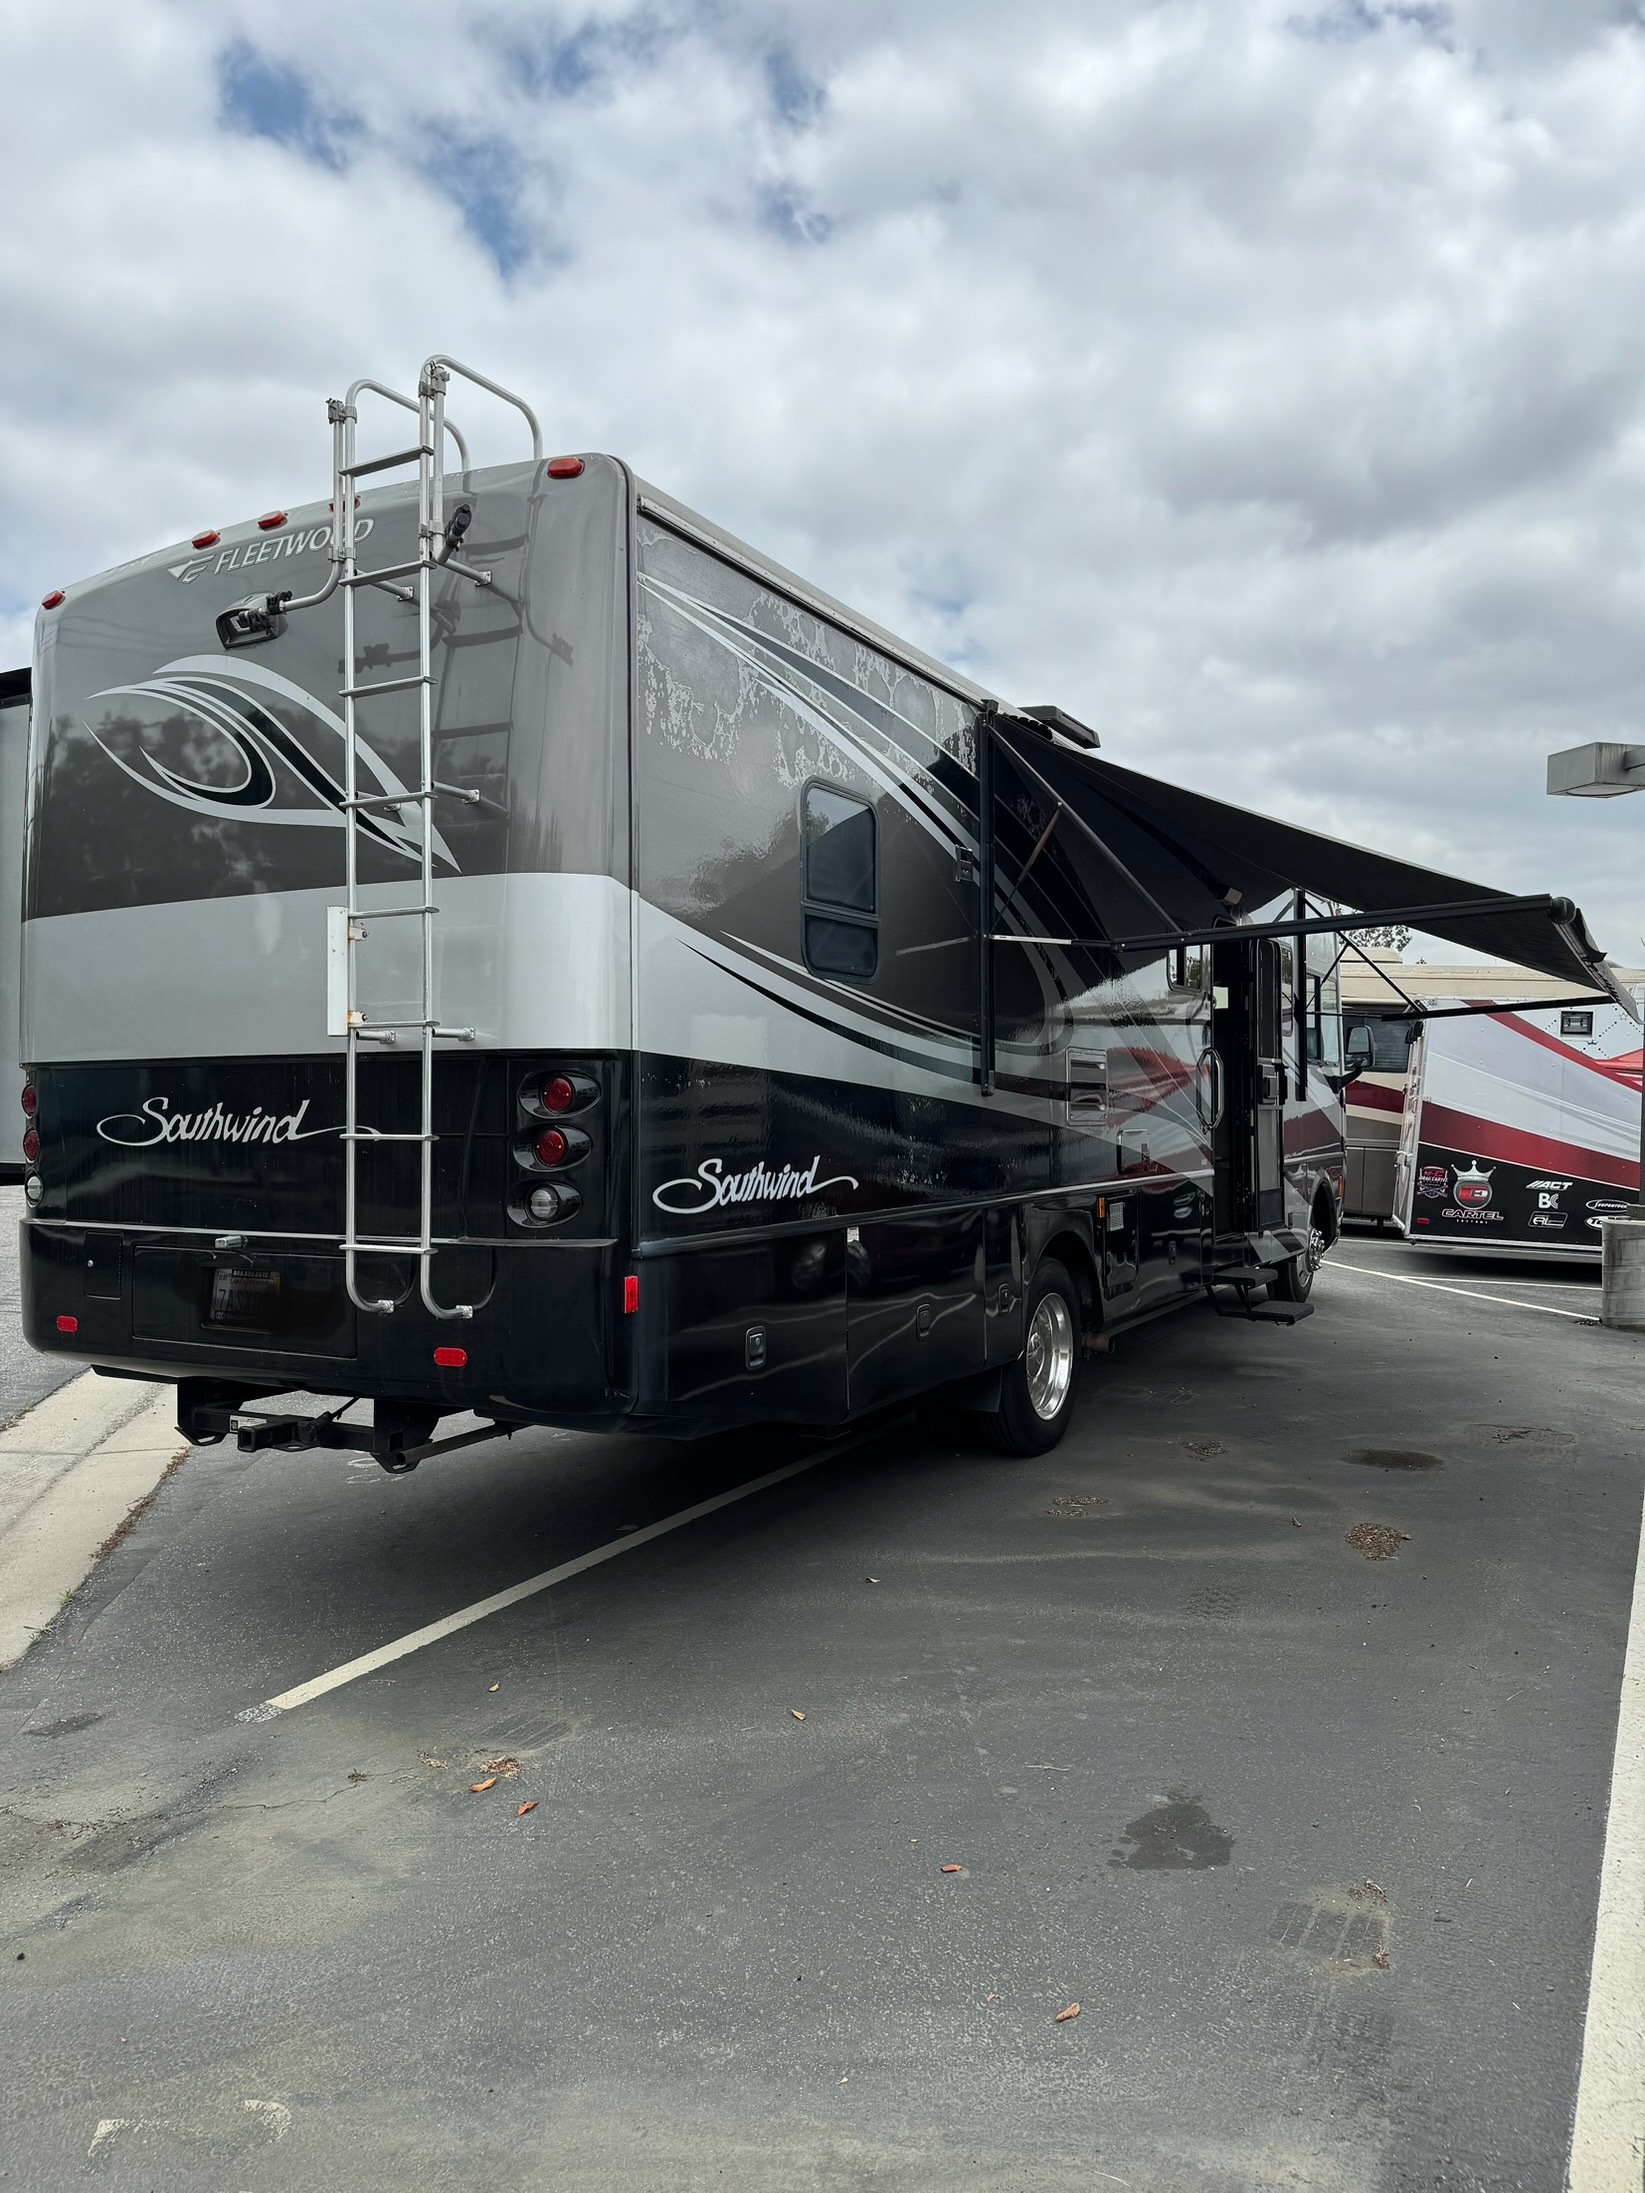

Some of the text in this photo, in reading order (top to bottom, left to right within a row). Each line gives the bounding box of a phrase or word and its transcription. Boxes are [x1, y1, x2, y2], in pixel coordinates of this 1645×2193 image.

[214, 518, 375, 575] FLEETWOD
[96, 1096, 382, 1147] Southwind
[652, 1155, 859, 1214] Southwind
[1441, 1208, 1504, 1221] CARTEL
